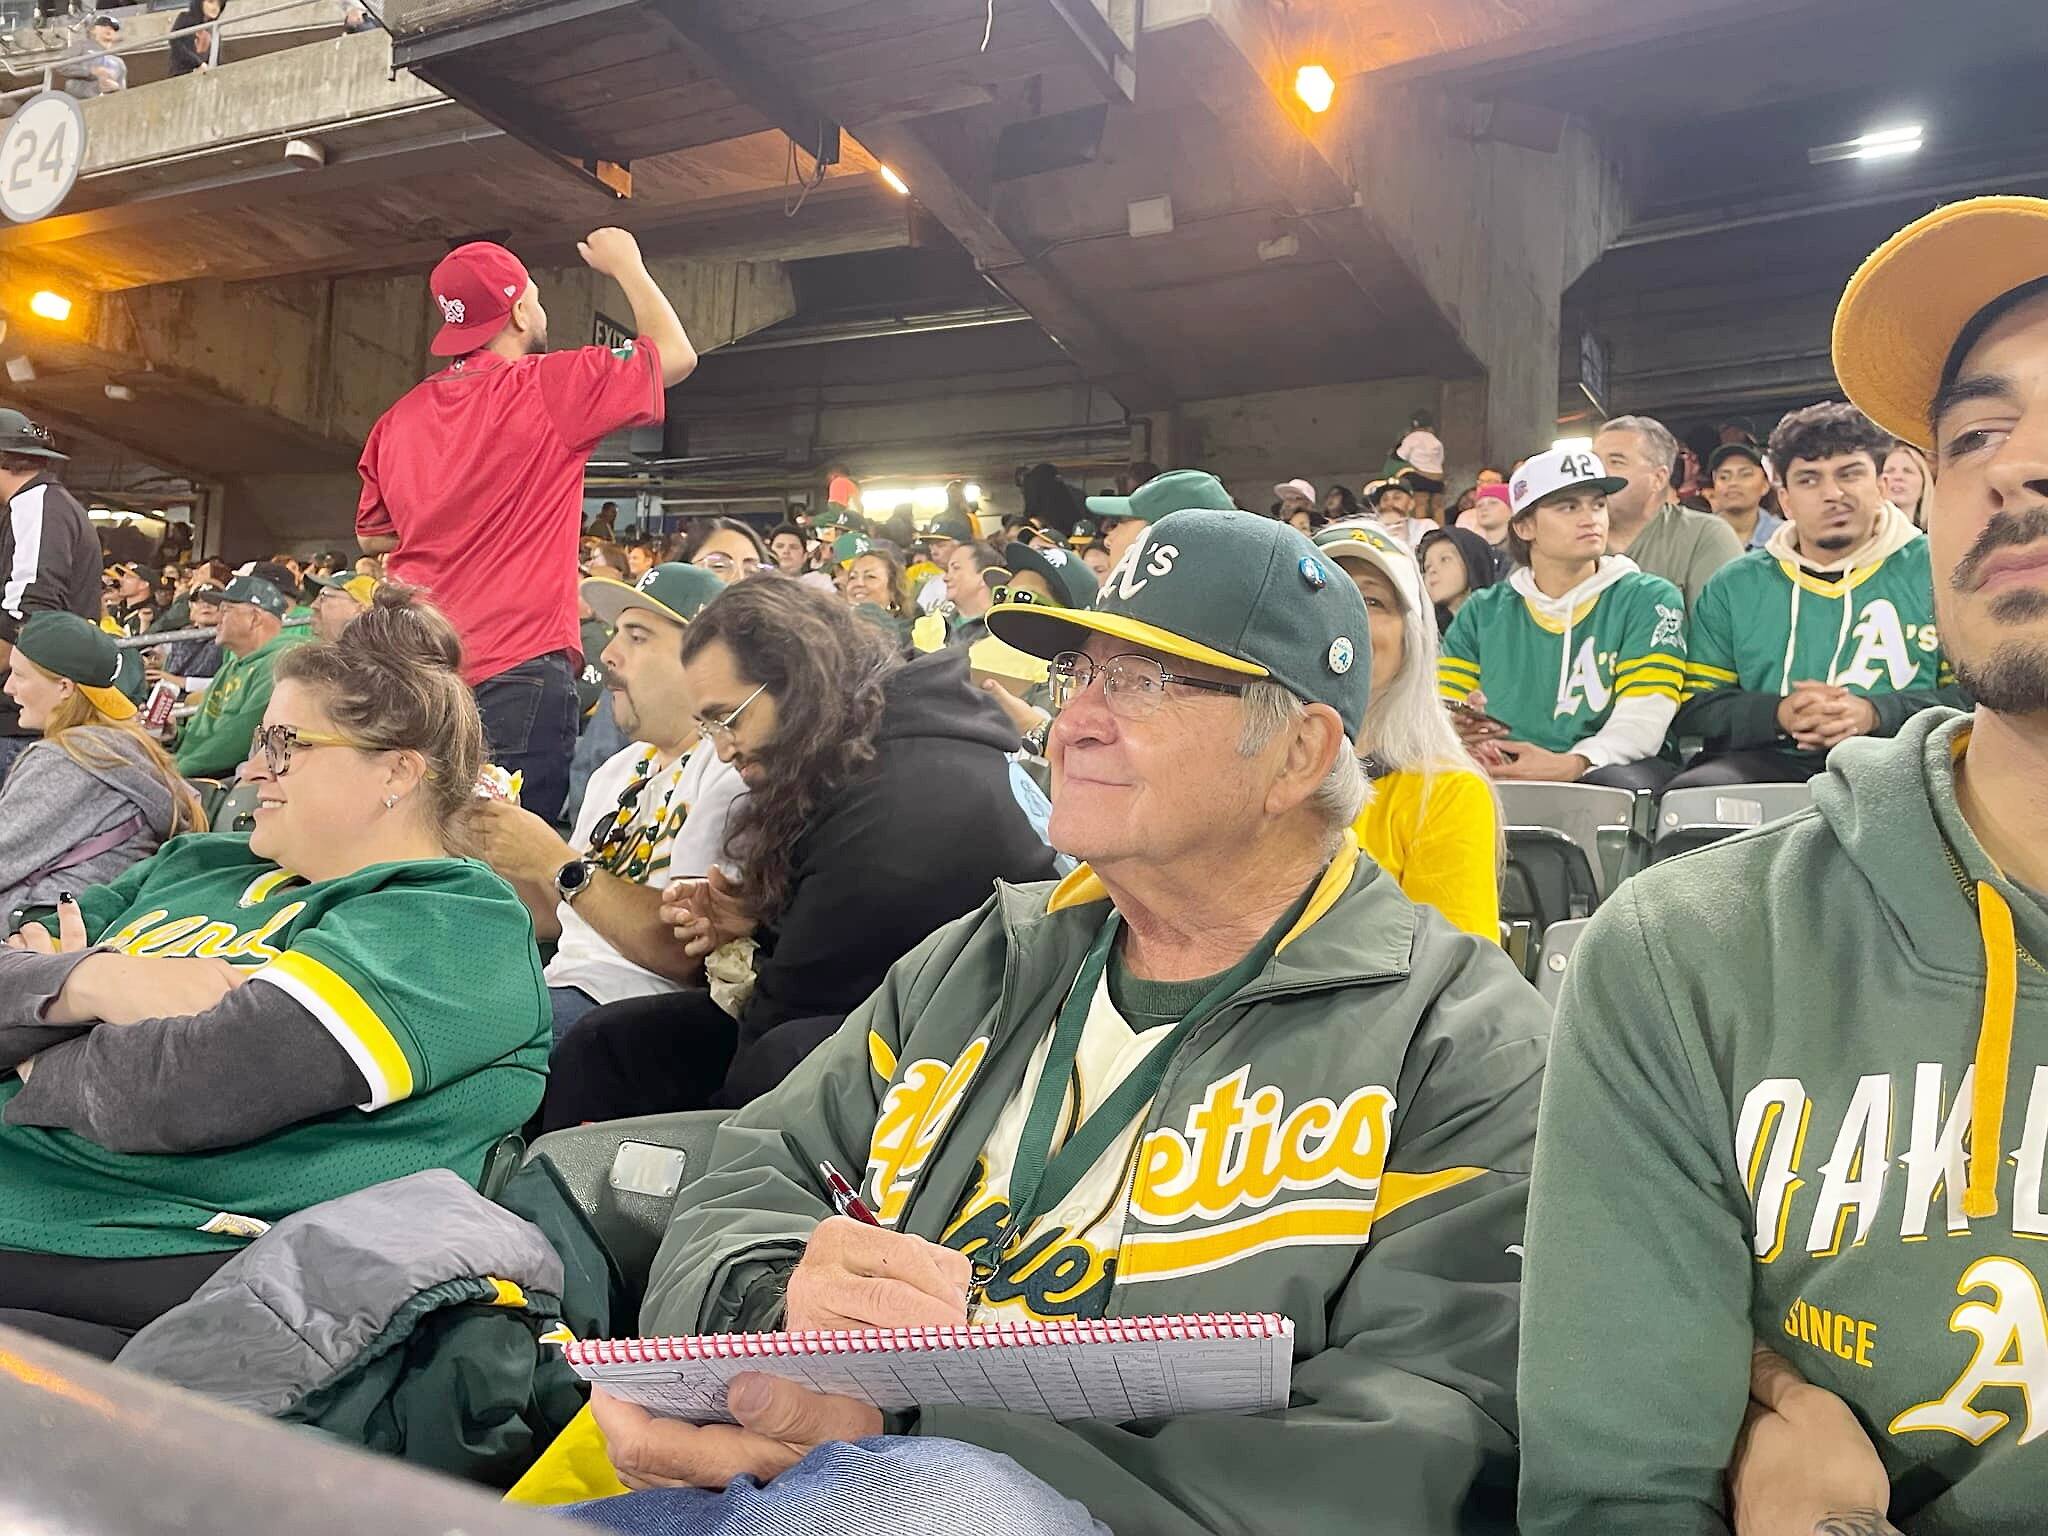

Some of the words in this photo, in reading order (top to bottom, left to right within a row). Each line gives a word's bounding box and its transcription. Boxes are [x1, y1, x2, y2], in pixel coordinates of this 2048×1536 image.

[9, 121, 67, 192] 24
[1560, 454, 1596, 478] 42
[1095, 525, 1180, 606] A's
[1834, 598, 1940, 692] A's
[1784, 1296, 1878, 1368] SINCE
